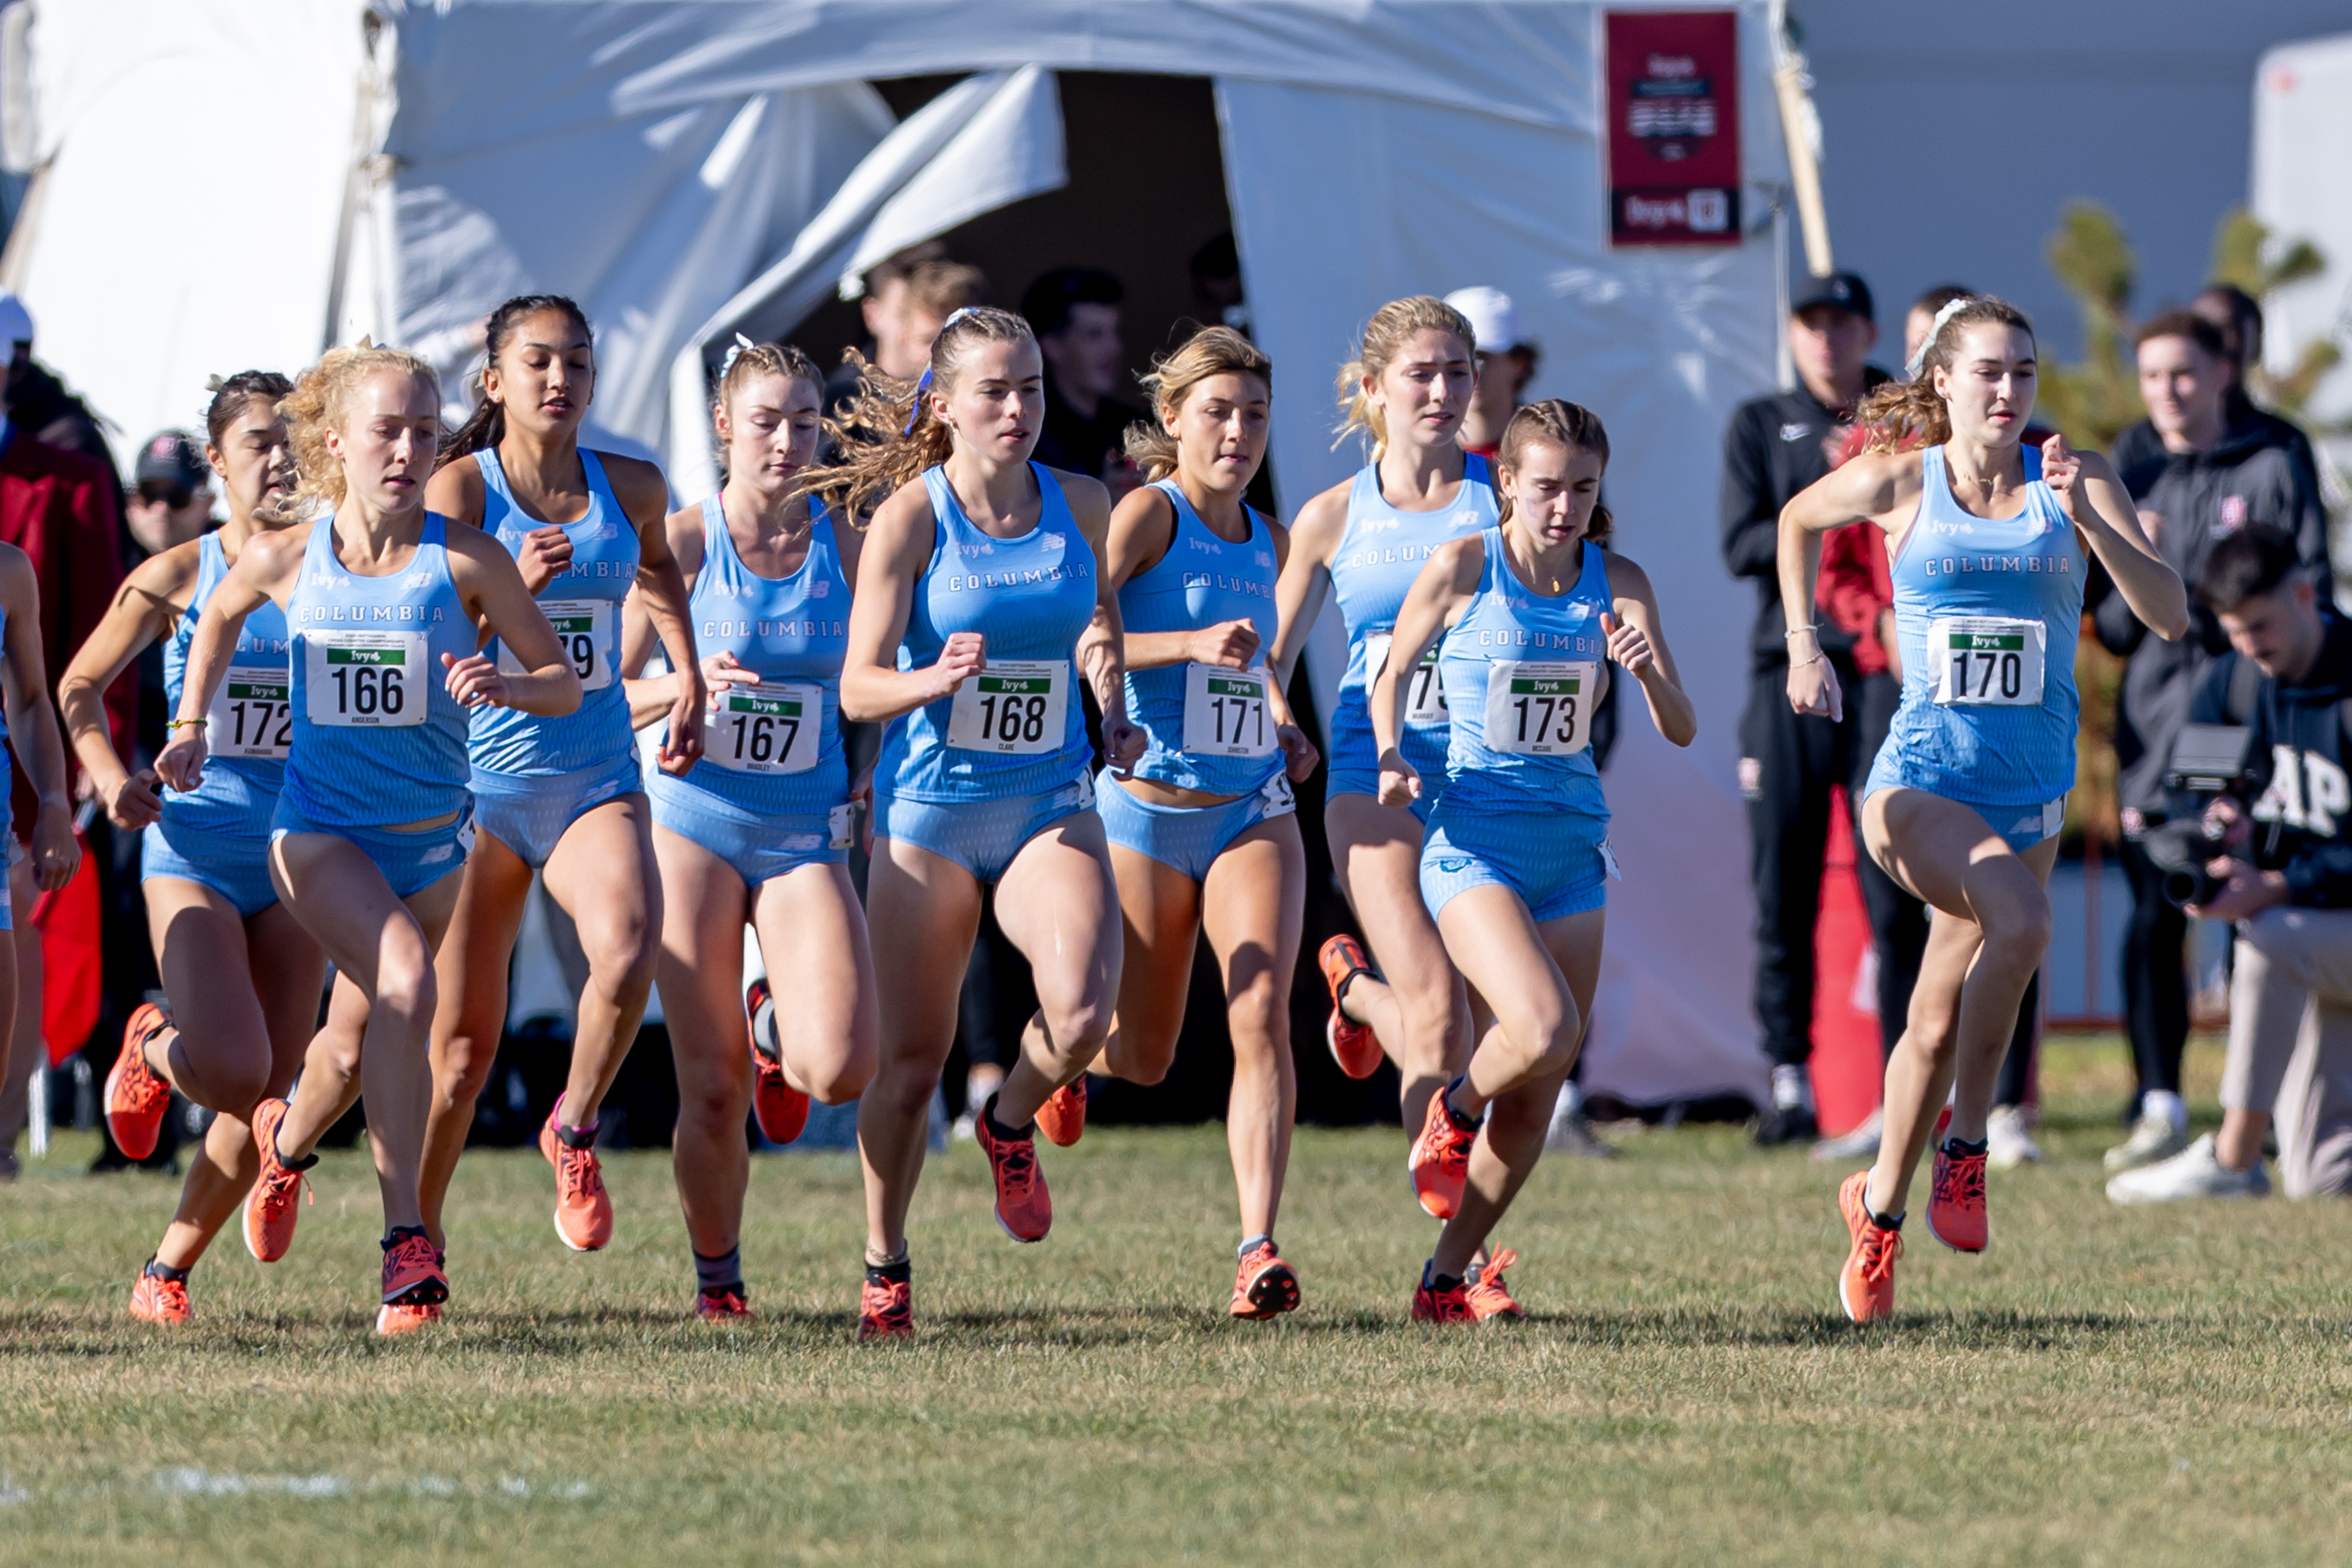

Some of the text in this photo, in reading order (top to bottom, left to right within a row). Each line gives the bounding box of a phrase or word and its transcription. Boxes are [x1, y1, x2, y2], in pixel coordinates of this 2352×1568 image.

[1360, 518, 1386, 533] Ivy
[1931, 520, 1958, 536] Ivy
[954, 541, 979, 558] Ivy
[1189, 537, 1210, 554] Ivy
[1924, 556, 2069, 576] COLUMBIA
[310, 572, 338, 591] Ivy
[949, 562, 1089, 592] COLUMBIA
[714, 580, 739, 599] Ivy
[1490, 591, 1515, 609] Ivy
[299, 605, 445, 623] COLUMBIA
[703, 619, 843, 638] COLUMBIA
[1972, 636, 1991, 648] Ivy
[351, 650, 371, 663] Ivy
[1953, 652, 2021, 699] 170
[250, 686, 269, 698] Ivy
[331, 666, 403, 715] 166
[1001, 679, 1019, 691] Ivy
[1227, 682, 1243, 694] Ivy
[1533, 681, 1551, 693] Ivy
[752, 699, 770, 712] Ivy
[230, 701, 293, 746] 172
[980, 695, 1047, 742] 168
[1211, 697, 1262, 746] 171
[1513, 697, 1576, 743] 173
[732, 715, 800, 764] 167
[746, 763, 771, 772] BRADLEY
